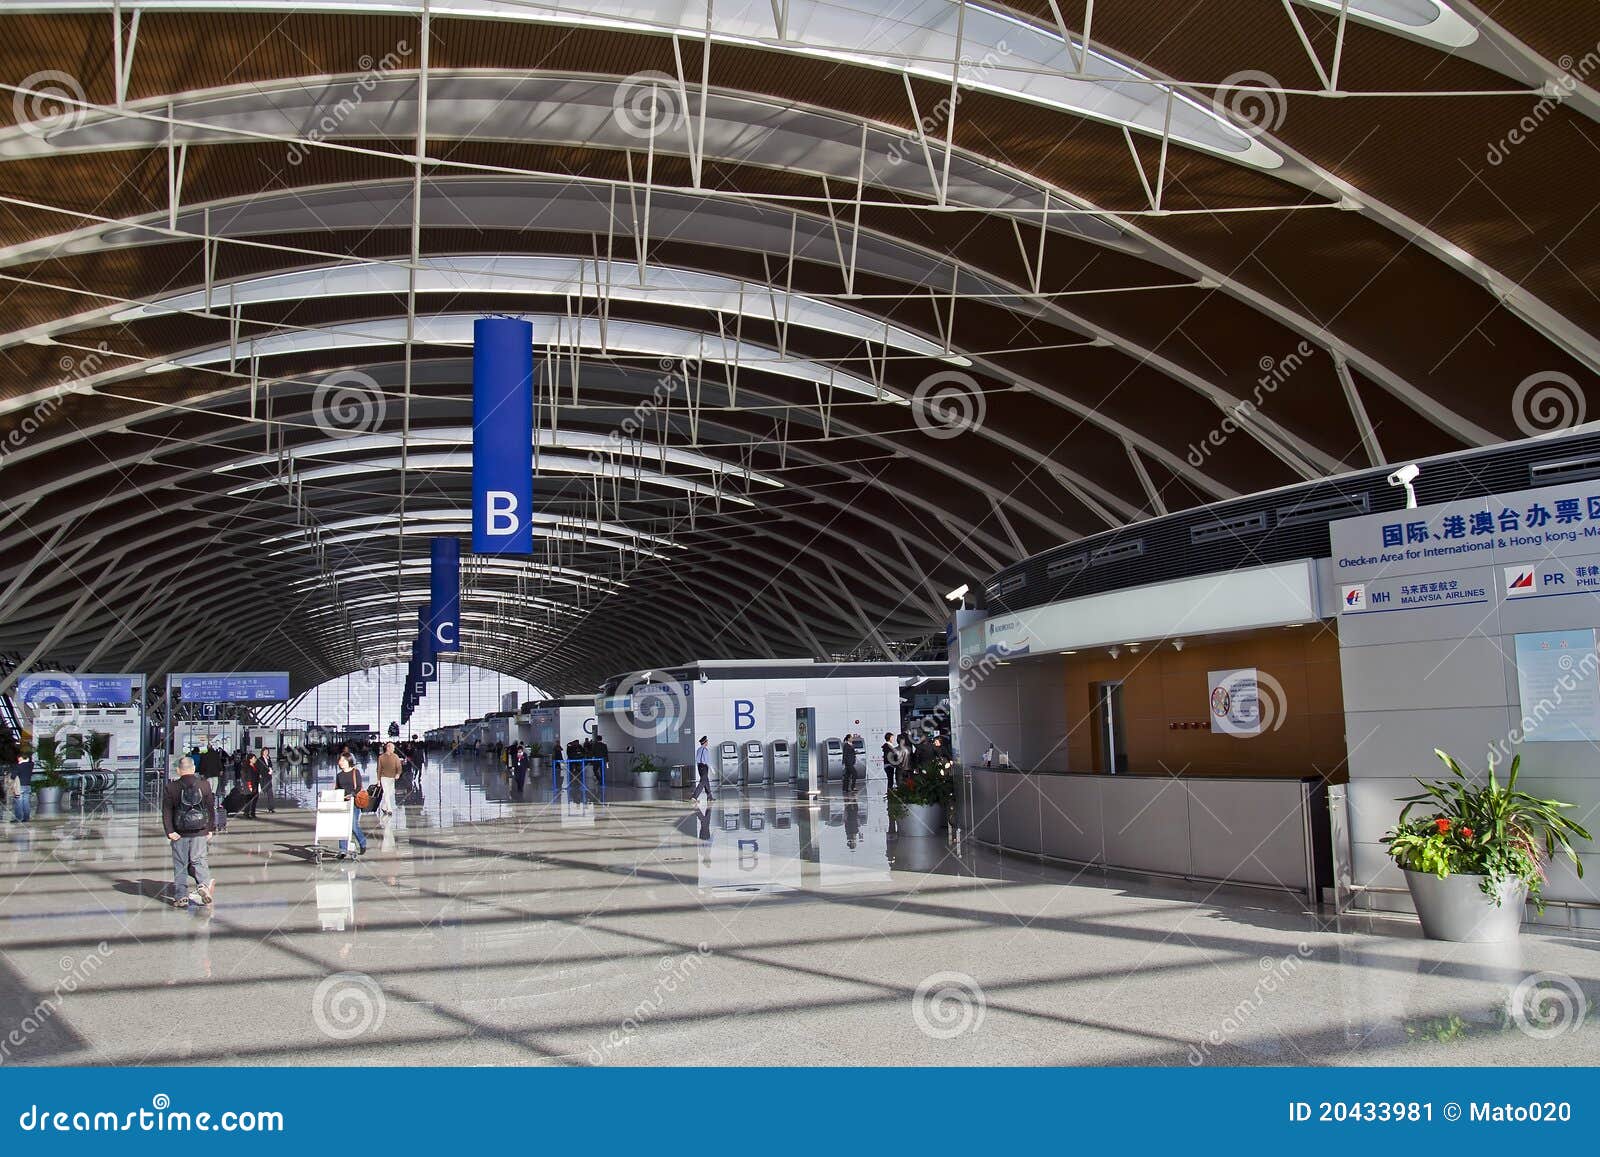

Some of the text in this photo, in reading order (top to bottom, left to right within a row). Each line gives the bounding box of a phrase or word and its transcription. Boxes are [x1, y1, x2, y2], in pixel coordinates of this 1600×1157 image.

[487, 491, 519, 535] B
[1339, 556, 1378, 568] Check-in
[1380, 552, 1403, 563] Area
[1405, 549, 1421, 560] for
[1423, 539, 1494, 557] International
[1498, 538, 1506, 548] &
[1509, 535, 1542, 546] Hong
[1543, 573, 1566, 586] PR
[1401, 580, 1458, 595] 马来西亚航空
[1372, 591, 1391, 604] MH
[1401, 588, 1485, 604] MALAYSIA AIRLINES
[436, 621, 454, 644] C
[421, 662, 435, 677] D
[415, 682, 424, 693] E
[683, 683, 690, 696] B
[734, 699, 756, 730] B
